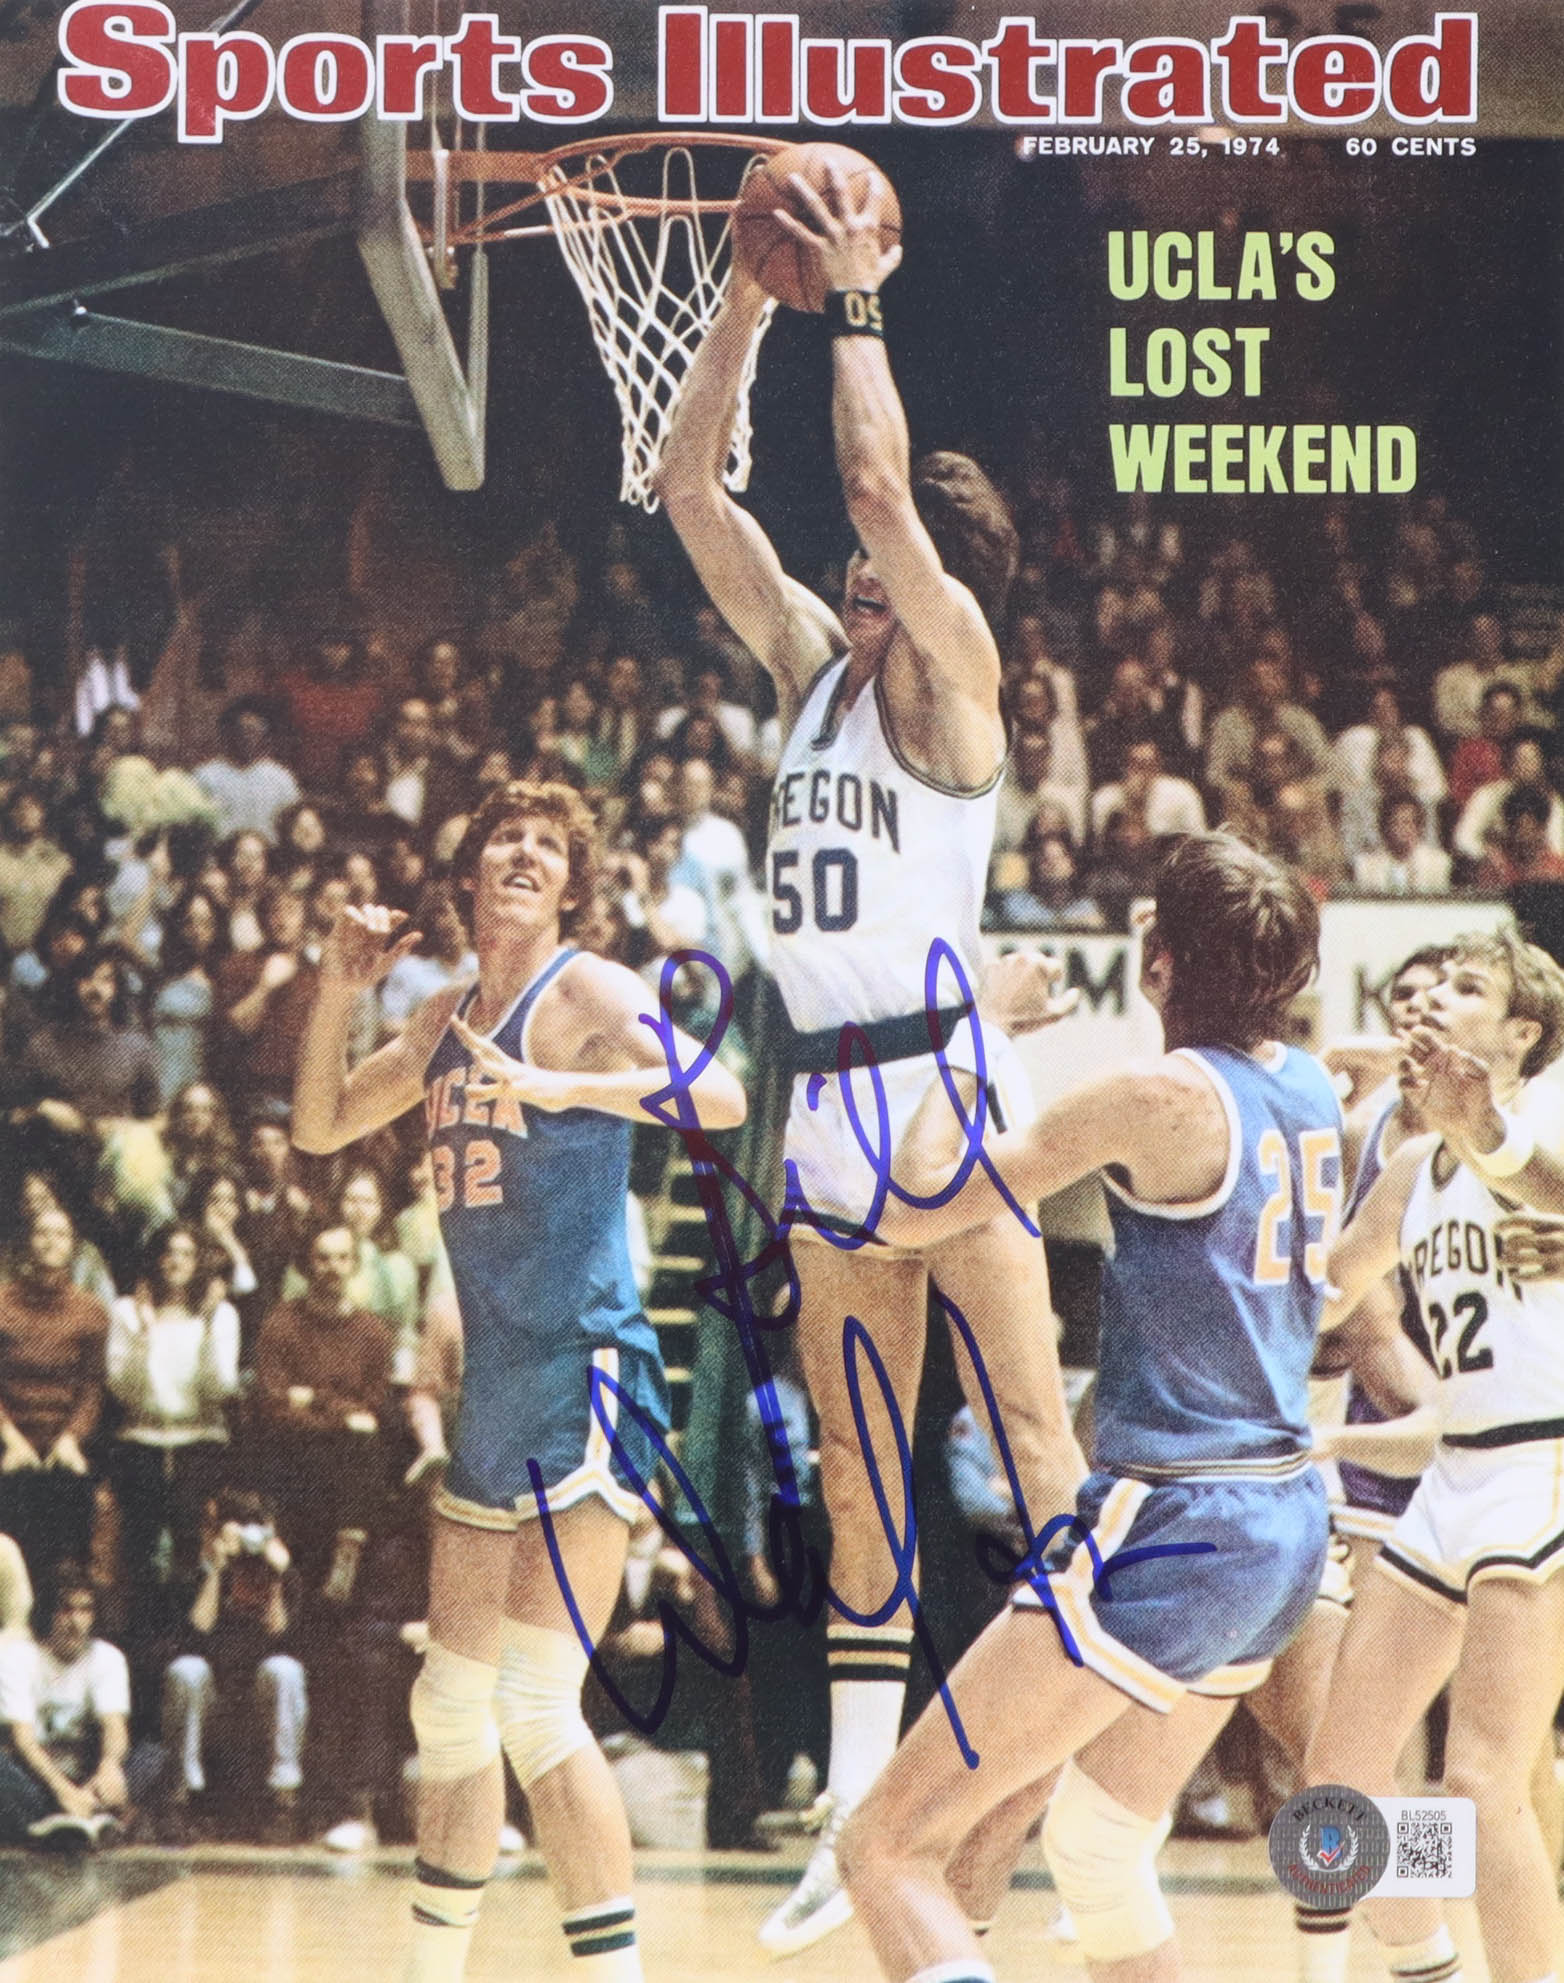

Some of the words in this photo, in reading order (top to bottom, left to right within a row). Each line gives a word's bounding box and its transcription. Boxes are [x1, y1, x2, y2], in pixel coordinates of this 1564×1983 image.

[57, 0, 614, 145] Sports
[657, 5, 1478, 126] Illustrated
[1022, 136, 1155, 155] FEBRUARY
[1169, 136, 1208, 159] 25,
[1220, 136, 1281, 156] 1974
[1345, 136, 1378, 156] 60
[1390, 136, 1477, 156] CENTS
[1108, 230, 1336, 301] UCLA'S
[1109, 327, 1271, 398] LOST
[1108, 423, 1418, 494] WEEKEND
[772, 848, 859, 934] 50
[430, 1139, 504, 1215] 32
[1253, 1128, 1341, 1286] 25
[1293, 1796, 1367, 1822] BECKETT
[1400, 1809, 1448, 1822] BL52505
